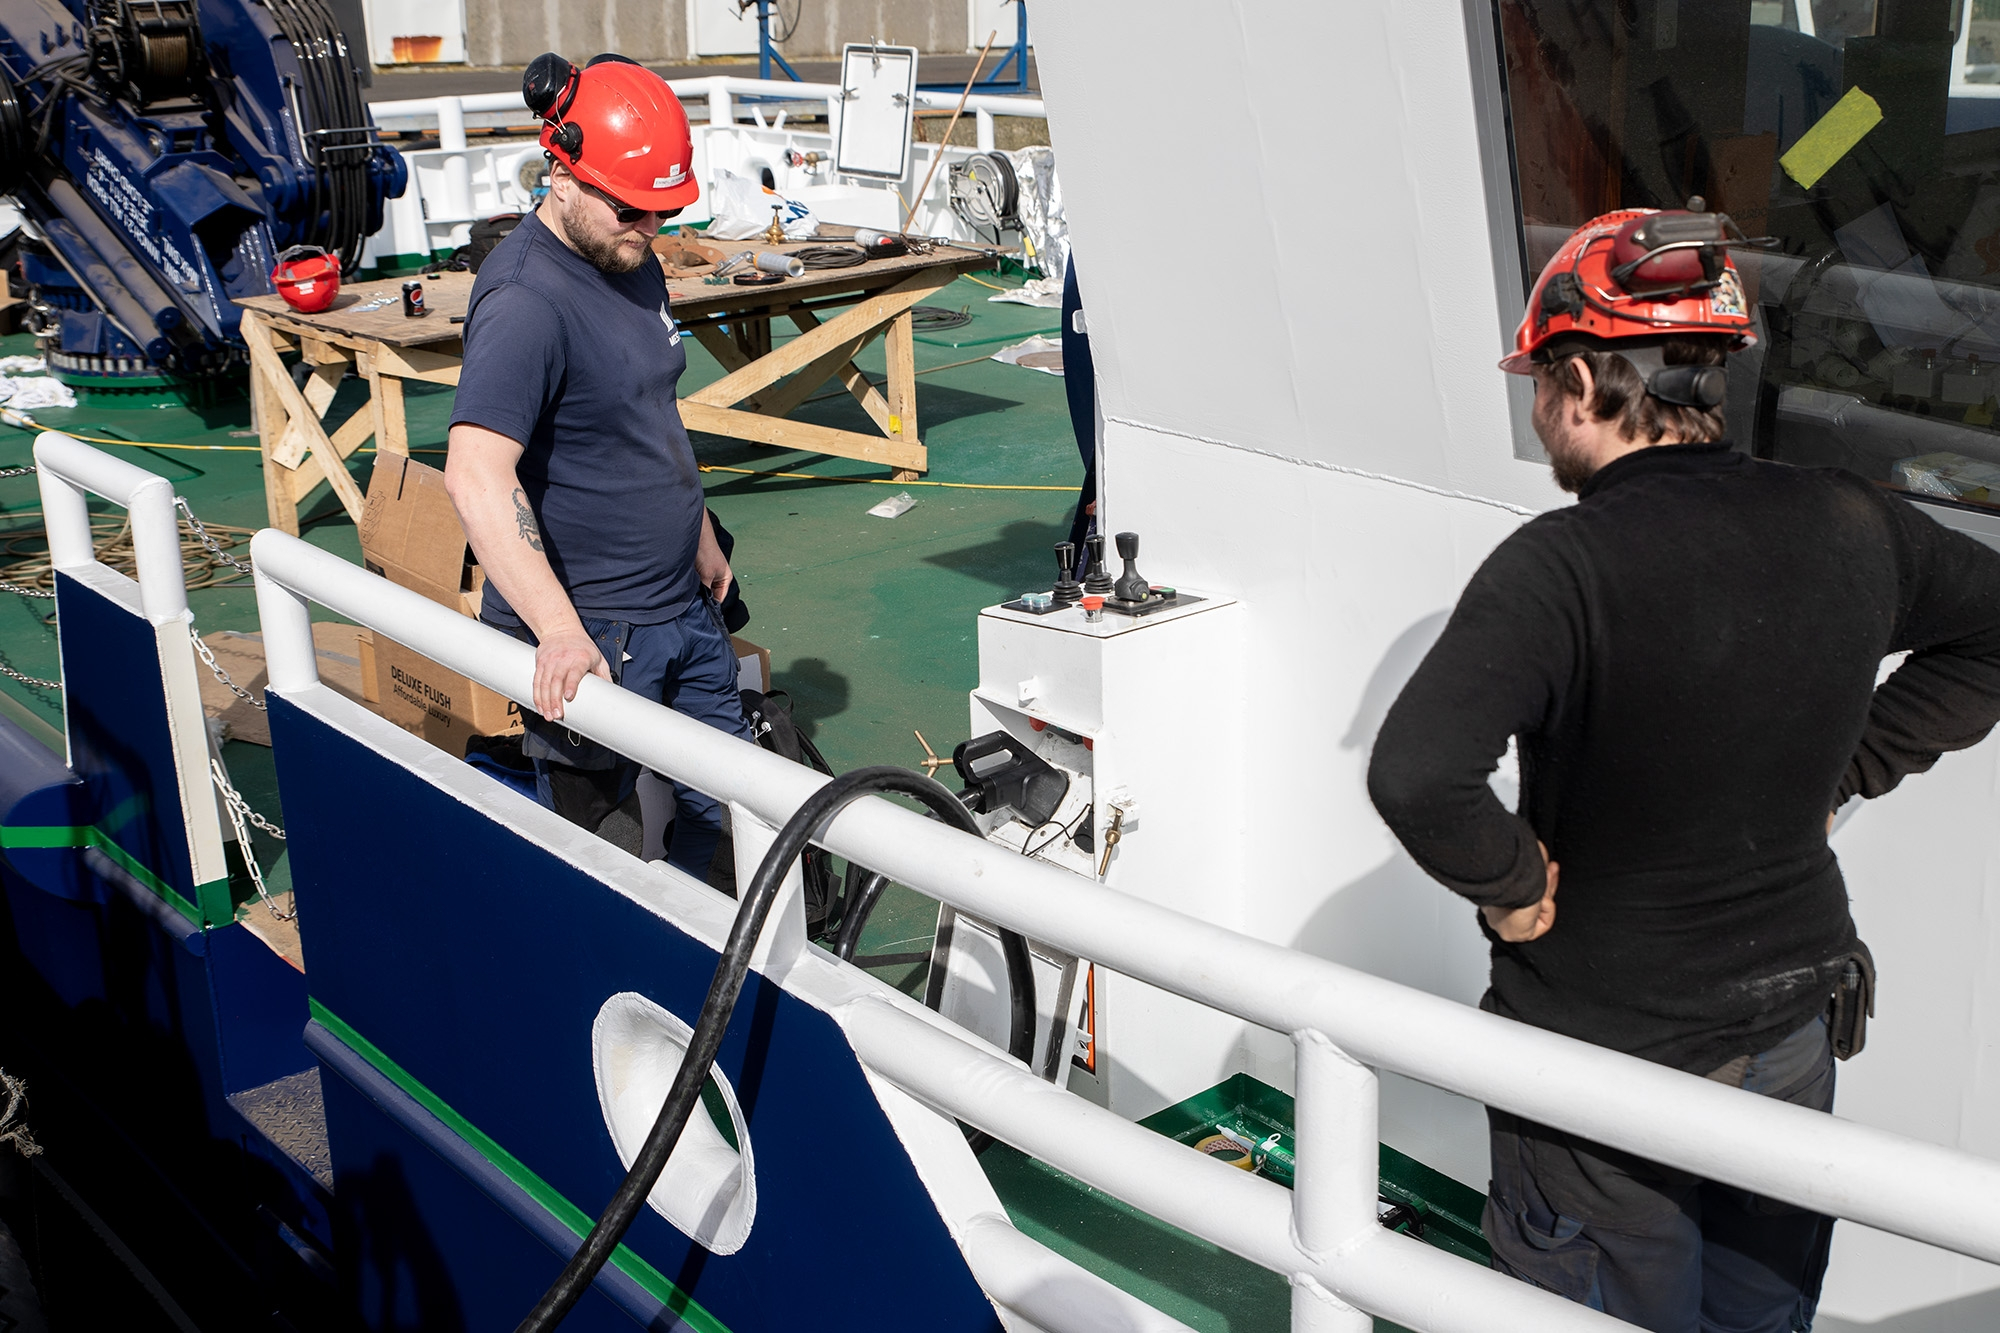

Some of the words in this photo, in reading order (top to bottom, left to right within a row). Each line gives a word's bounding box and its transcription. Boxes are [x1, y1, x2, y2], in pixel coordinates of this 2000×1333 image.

[391, 665, 422, 694] DELUXE
[424, 683, 451, 711] FLUSH
[393, 683, 428, 712] Affordable
[428, 705, 451, 728] Luxury
